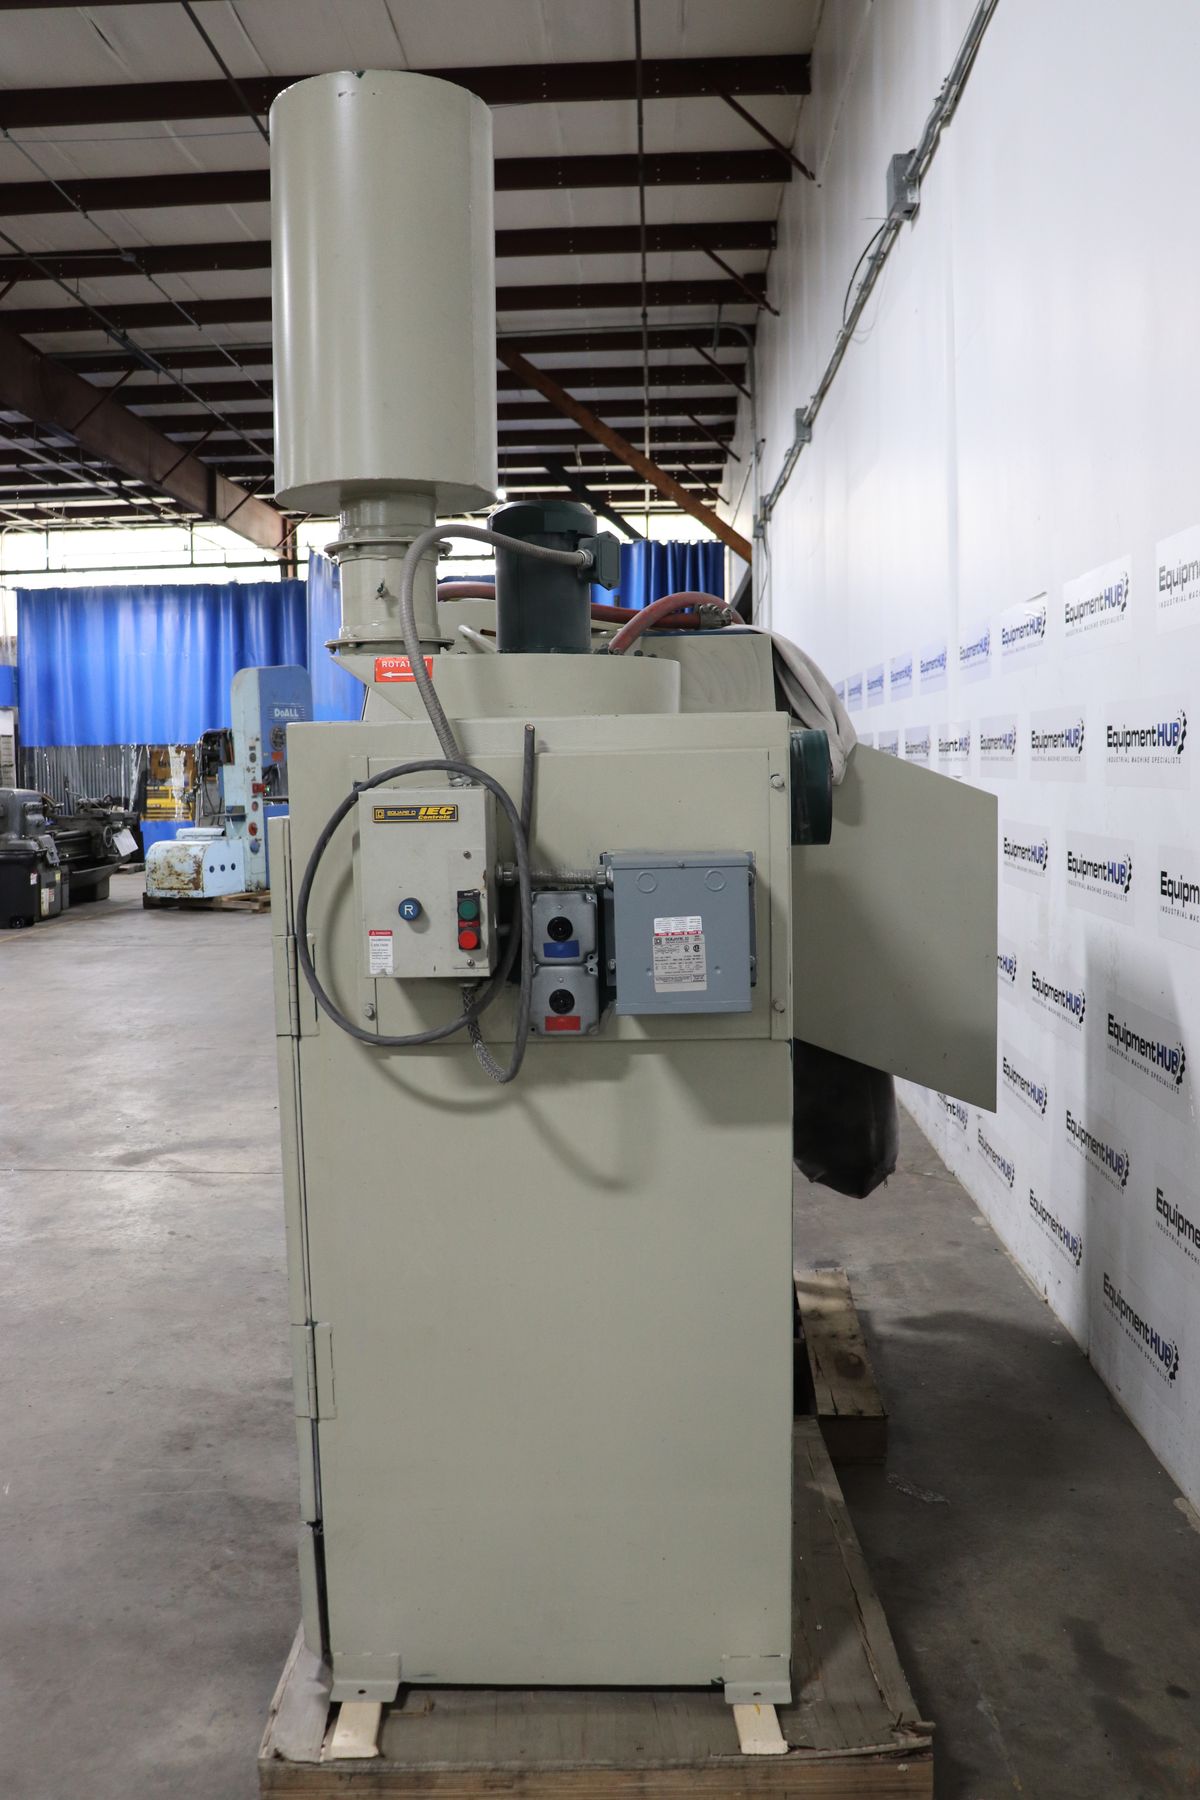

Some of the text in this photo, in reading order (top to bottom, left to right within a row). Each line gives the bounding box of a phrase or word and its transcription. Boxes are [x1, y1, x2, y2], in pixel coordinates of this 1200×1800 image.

[1159, 559, 1200, 595] Equipm
[381, 660, 428, 668] ROTAT
[274, 708, 299, 718] DoALL
[1107, 722, 1180, 754] EquipmentHUB
[419, 807, 455, 815] IEC
[1068, 851, 1126, 885] EquipmentHUB
[404, 904, 414, 915] R
[1108, 1013, 1179, 1075] EquipmentHUB
